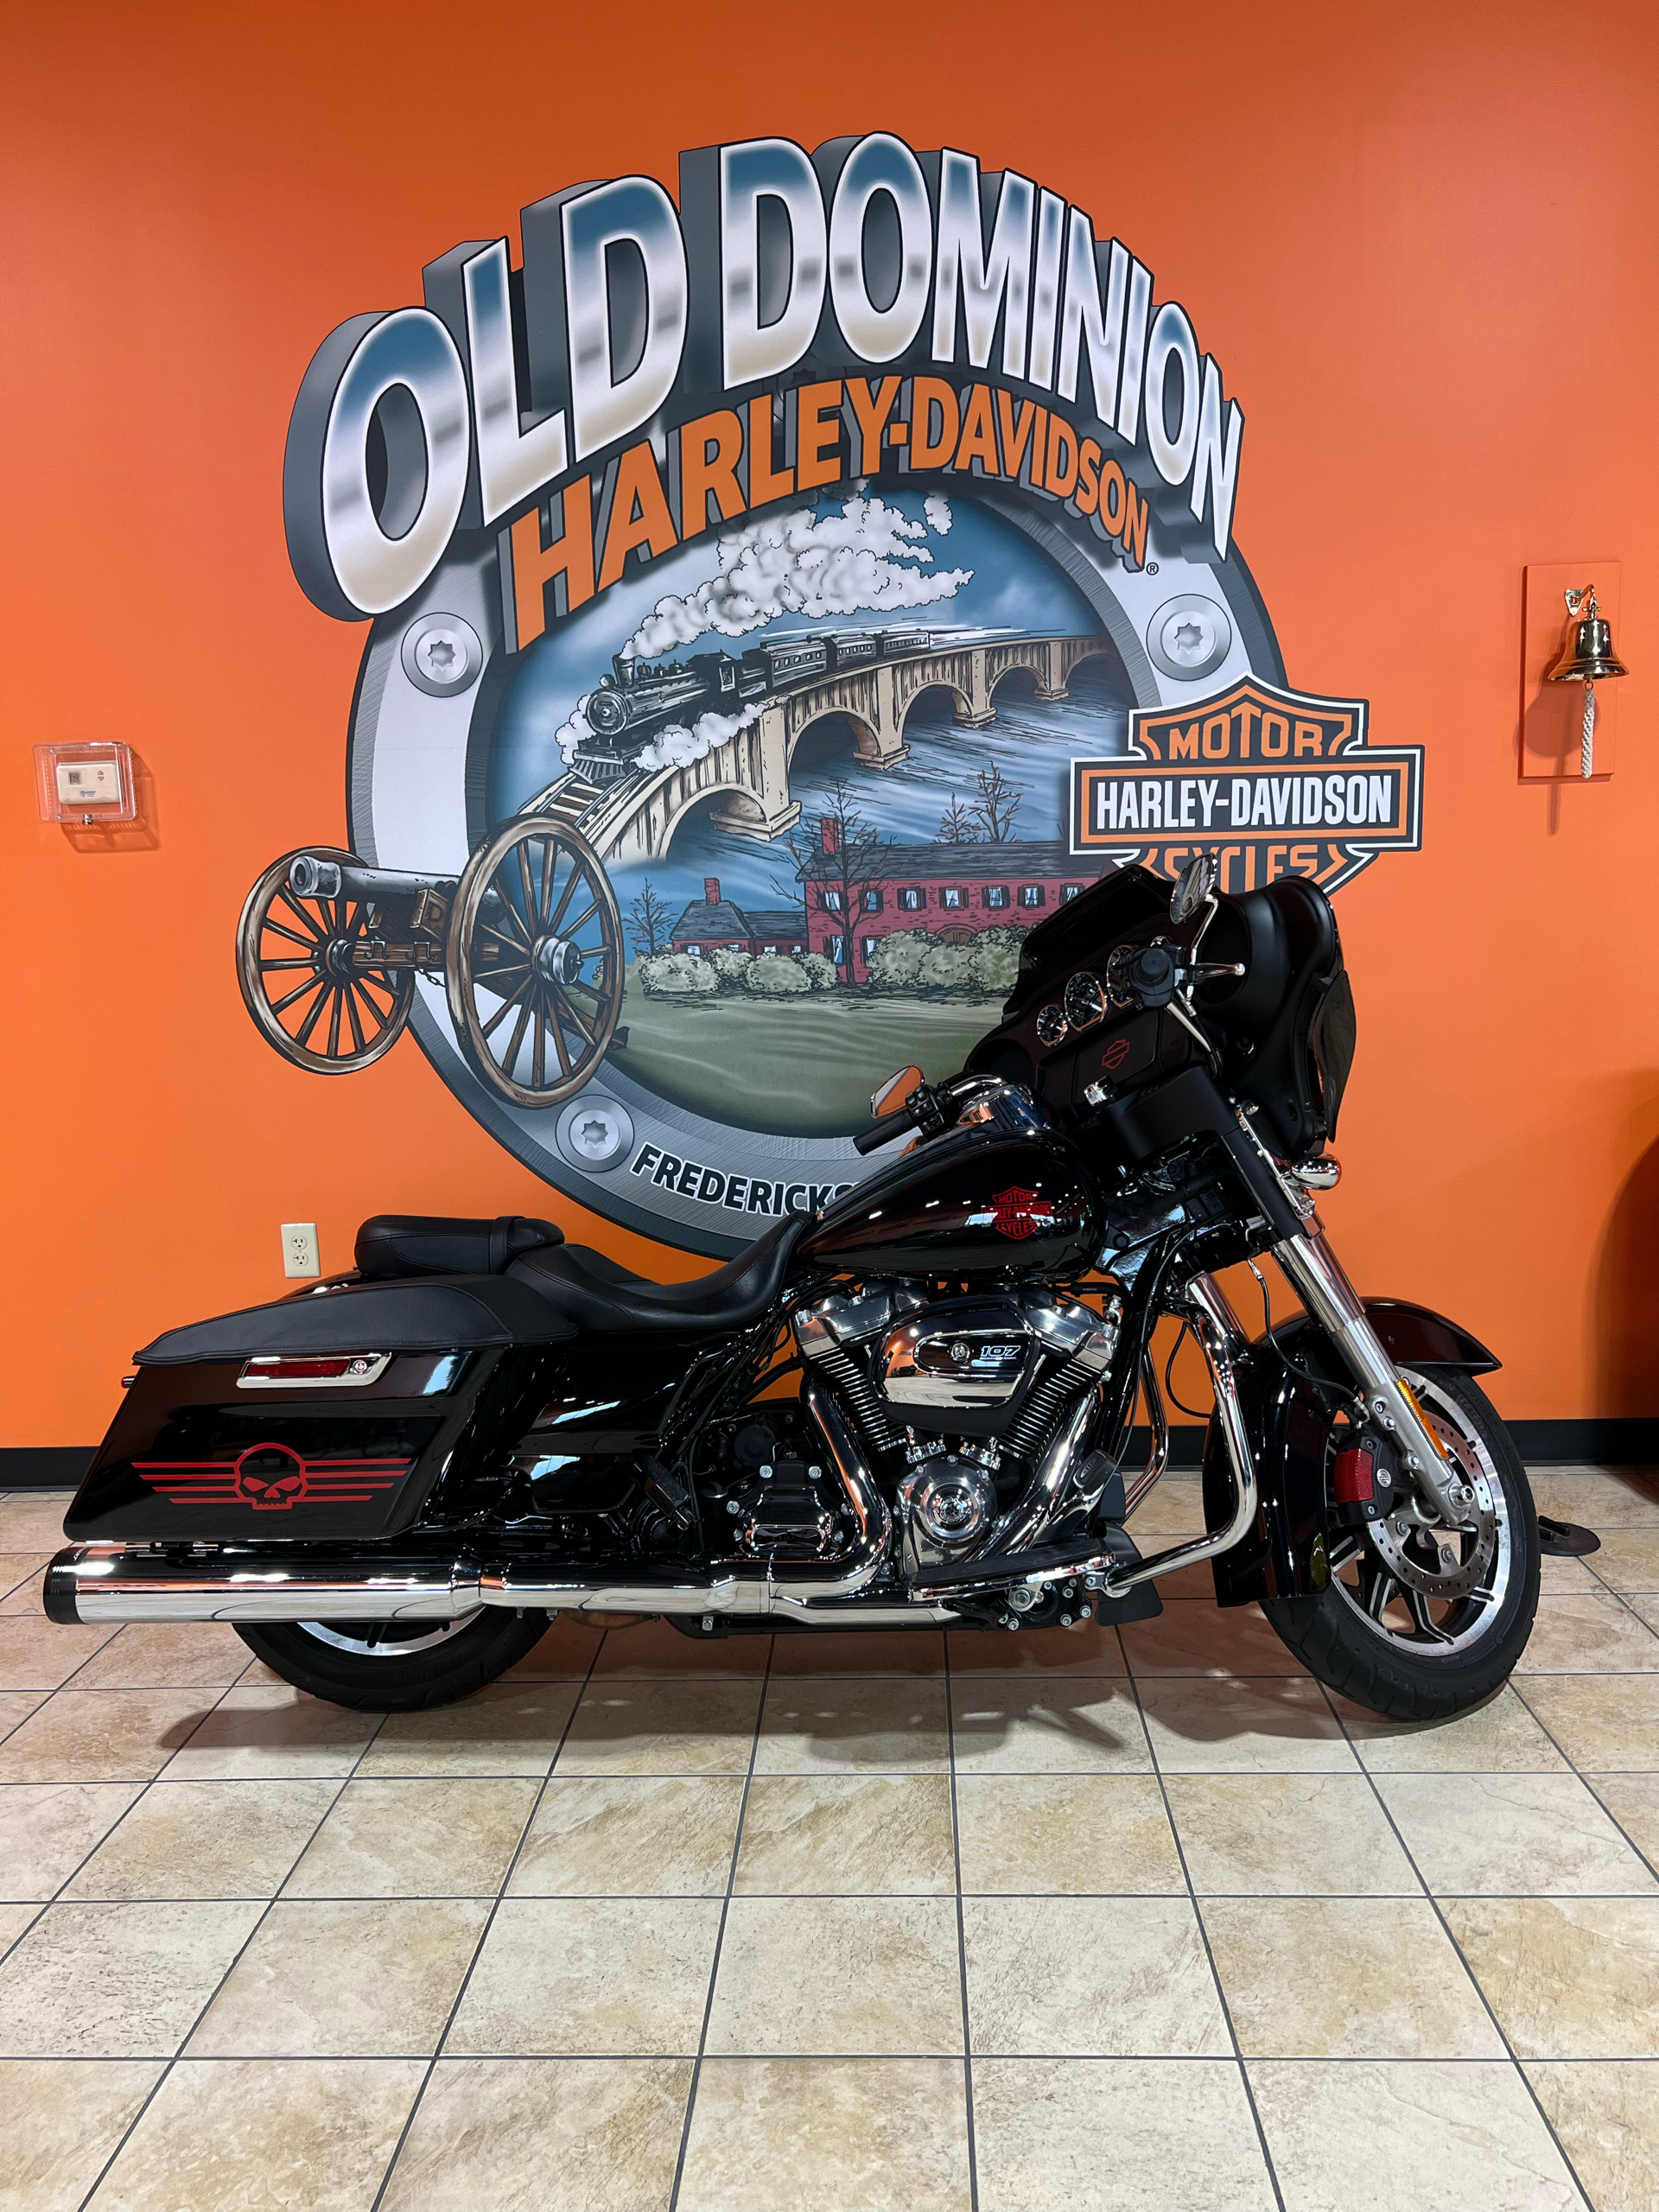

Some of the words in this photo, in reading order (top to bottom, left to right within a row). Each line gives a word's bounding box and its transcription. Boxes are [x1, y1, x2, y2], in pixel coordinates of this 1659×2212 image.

[316, 173, 690, 615] OLD
[719, 131, 1245, 563] DOMINION
[508, 374, 1150, 653] HARLEY-DAVIDSON
[1168, 701, 1324, 760] MOTOR
[1096, 774, 1393, 830] HARLEY-DAVIDSON
[1164, 844, 1319, 893] CCLES
[998, 1190, 1033, 1204] MOTOR
[1001, 1221, 1036, 1236] CYCLES
[980, 1344, 1021, 1357] 107
